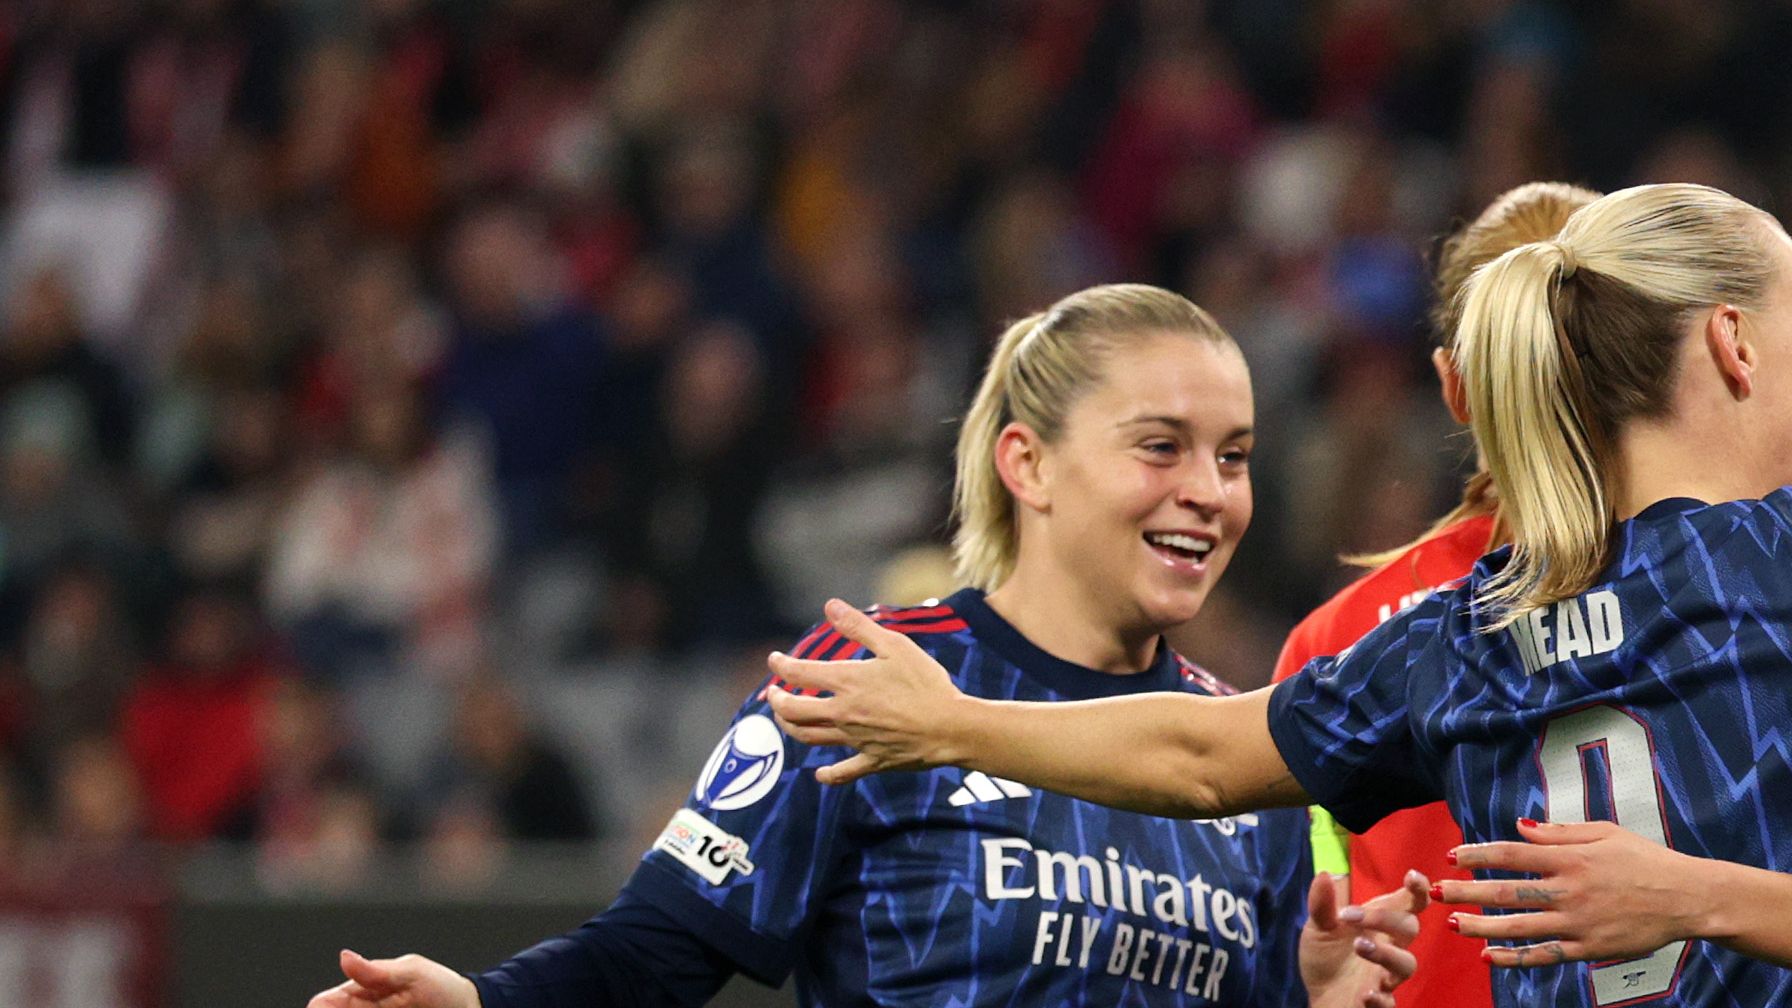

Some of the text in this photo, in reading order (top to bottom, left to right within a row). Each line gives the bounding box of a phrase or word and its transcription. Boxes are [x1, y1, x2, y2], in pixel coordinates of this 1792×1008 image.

[981, 837, 1255, 948] Emirates
[1032, 911, 1229, 1001] FLY BETTER
